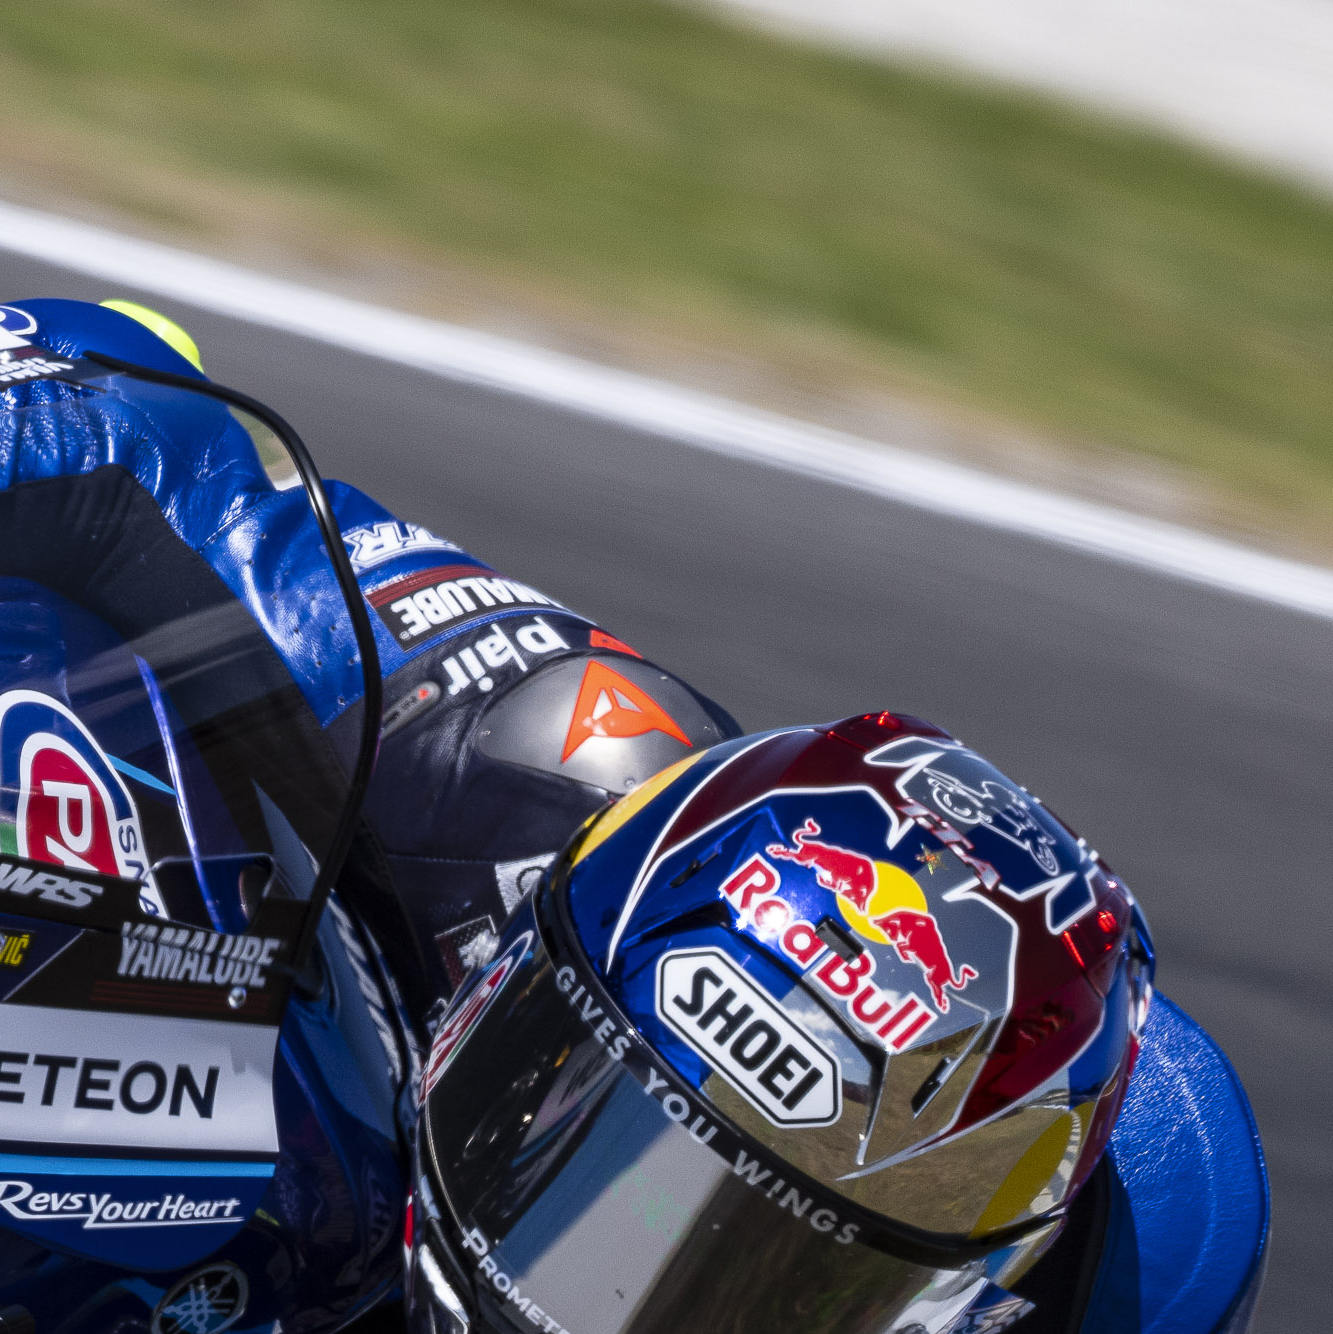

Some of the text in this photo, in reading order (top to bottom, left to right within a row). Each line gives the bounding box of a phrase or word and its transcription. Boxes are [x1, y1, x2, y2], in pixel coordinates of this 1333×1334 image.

[390, 577, 563, 638] MALUBE
[673, 967, 824, 1112] SHOEI
[815, 940, 939, 1054] Bull
[554, 965, 627, 1063] GIVES
[642, 1067, 721, 1145] YOU
[731, 1152, 862, 1247] WINGS
